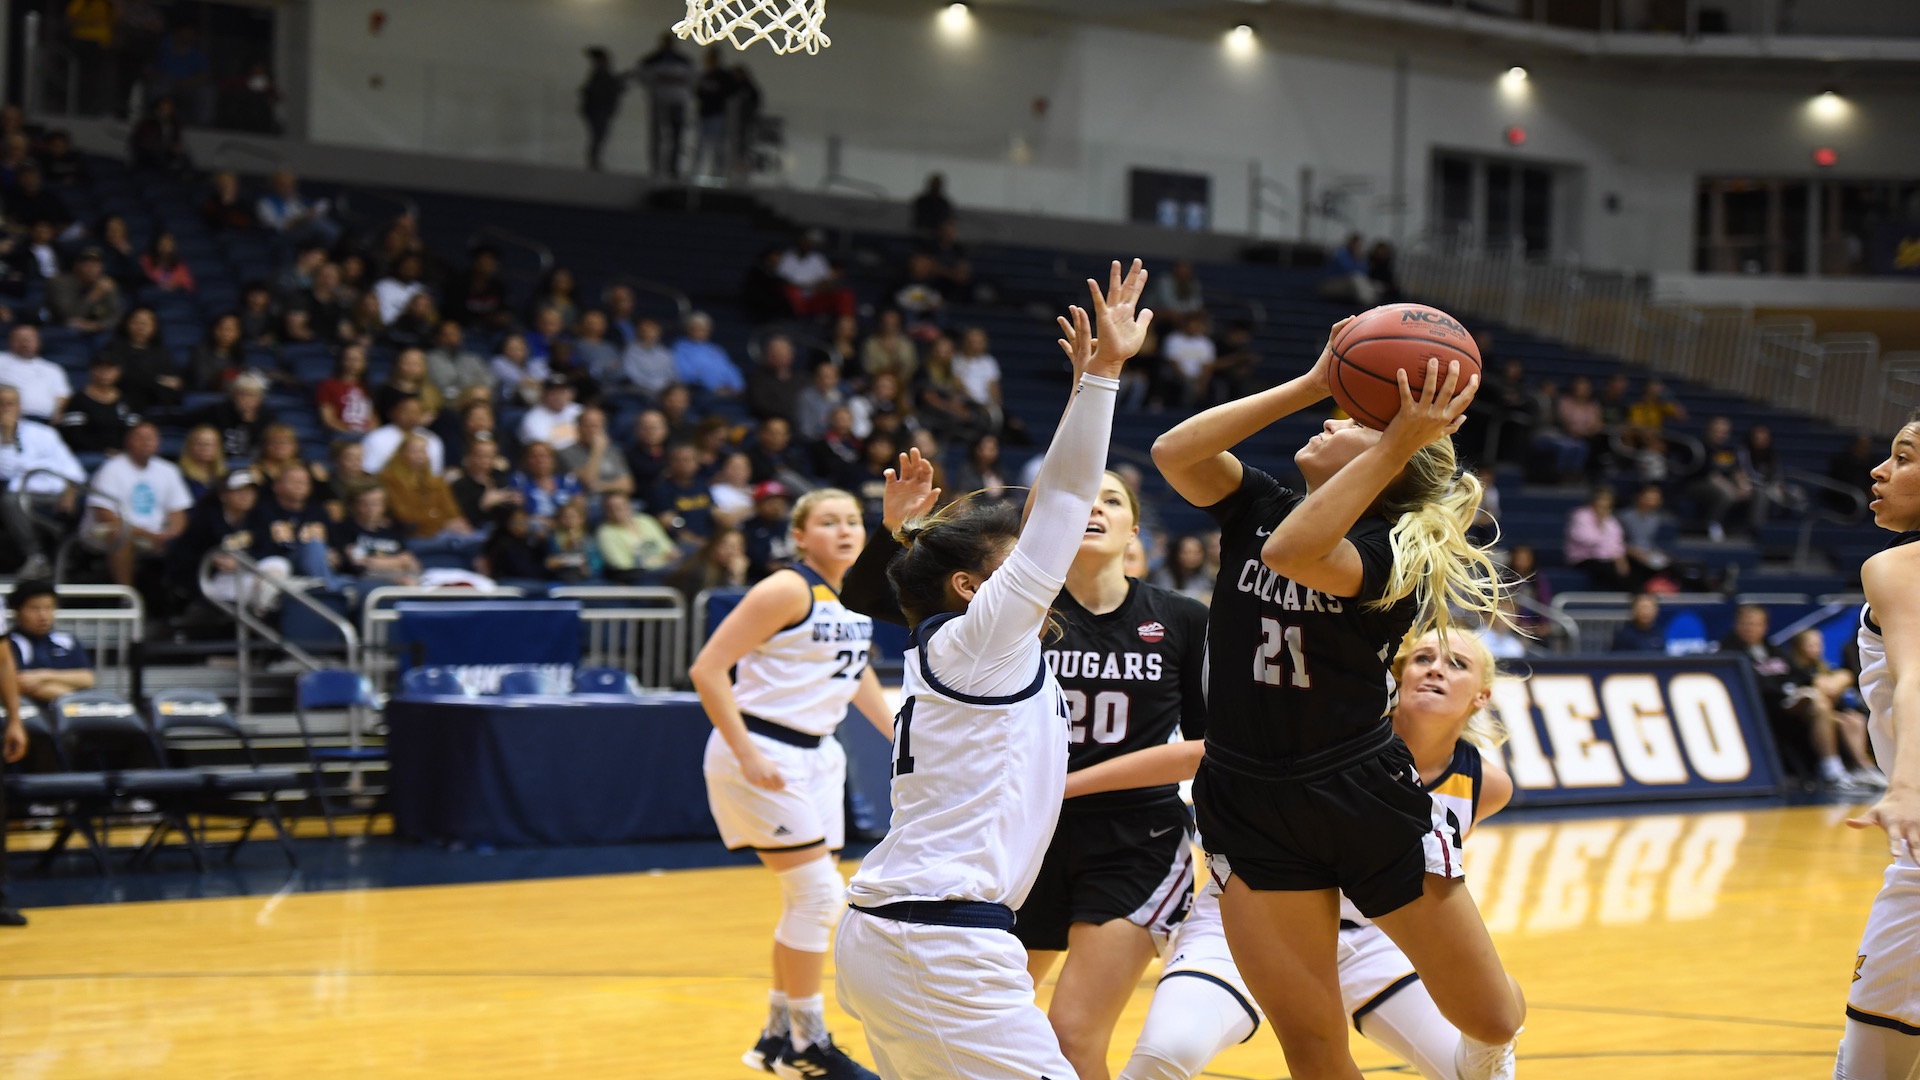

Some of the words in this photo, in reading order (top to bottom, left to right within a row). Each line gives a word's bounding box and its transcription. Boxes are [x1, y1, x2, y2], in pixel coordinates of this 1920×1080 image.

[1402, 310, 1466, 337] NCAA
[812, 622, 831, 642] UC
[831, 650, 868, 679] 22
[1044, 649, 1163, 681] OUGARS
[1252, 616, 1311, 689] 21
[1064, 689, 1130, 745] 20
[1482, 672, 1751, 789] IEGO
